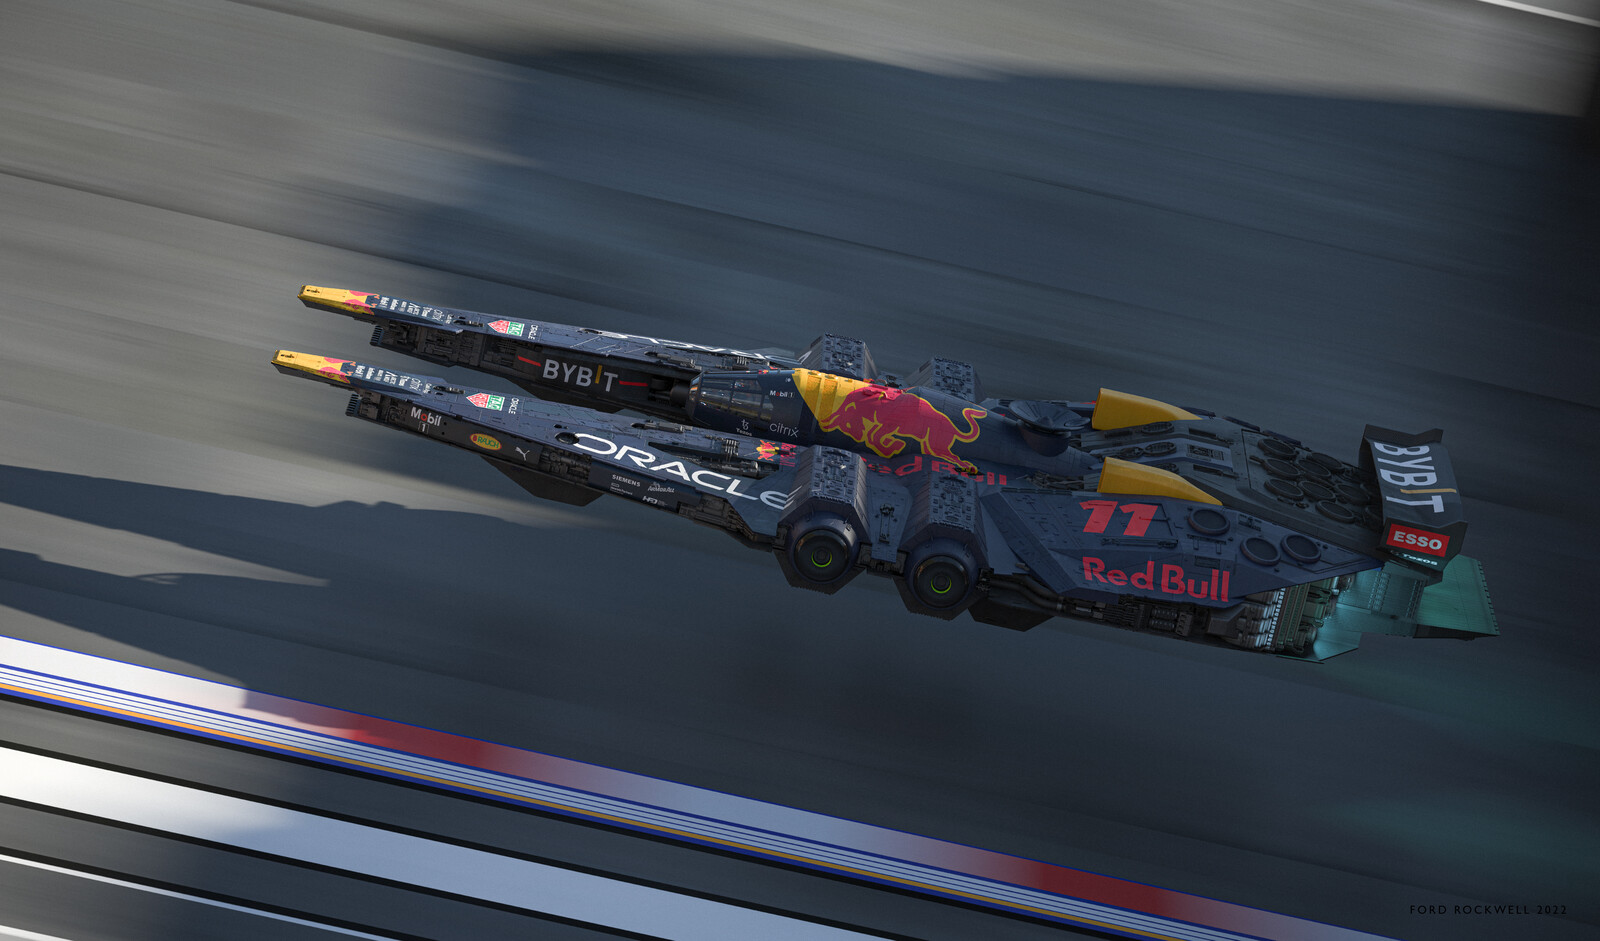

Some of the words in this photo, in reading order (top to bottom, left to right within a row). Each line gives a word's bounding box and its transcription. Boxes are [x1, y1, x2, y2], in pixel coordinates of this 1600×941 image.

[510, 322, 522, 335] TAG
[528, 324, 539, 340] ORACLE
[542, 359, 619, 393] BYBIT
[489, 396, 503, 409] TAG
[769, 390, 788, 398] Mobil
[508, 397, 519, 415] ORACLE
[410, 406, 442, 426] Mobil
[769, 422, 799, 438] citrix
[477, 436, 500, 449] RAUCH
[573, 432, 803, 511] ORACLE
[611, 474, 641, 487] SIEMENS
[1373, 441, 1457, 513] BYBIT
[1079, 500, 1159, 537] 11
[1393, 530, 1443, 550] ESSO
[1082, 556, 1155, 591] Red
[1160, 563, 1231, 603] Bull
